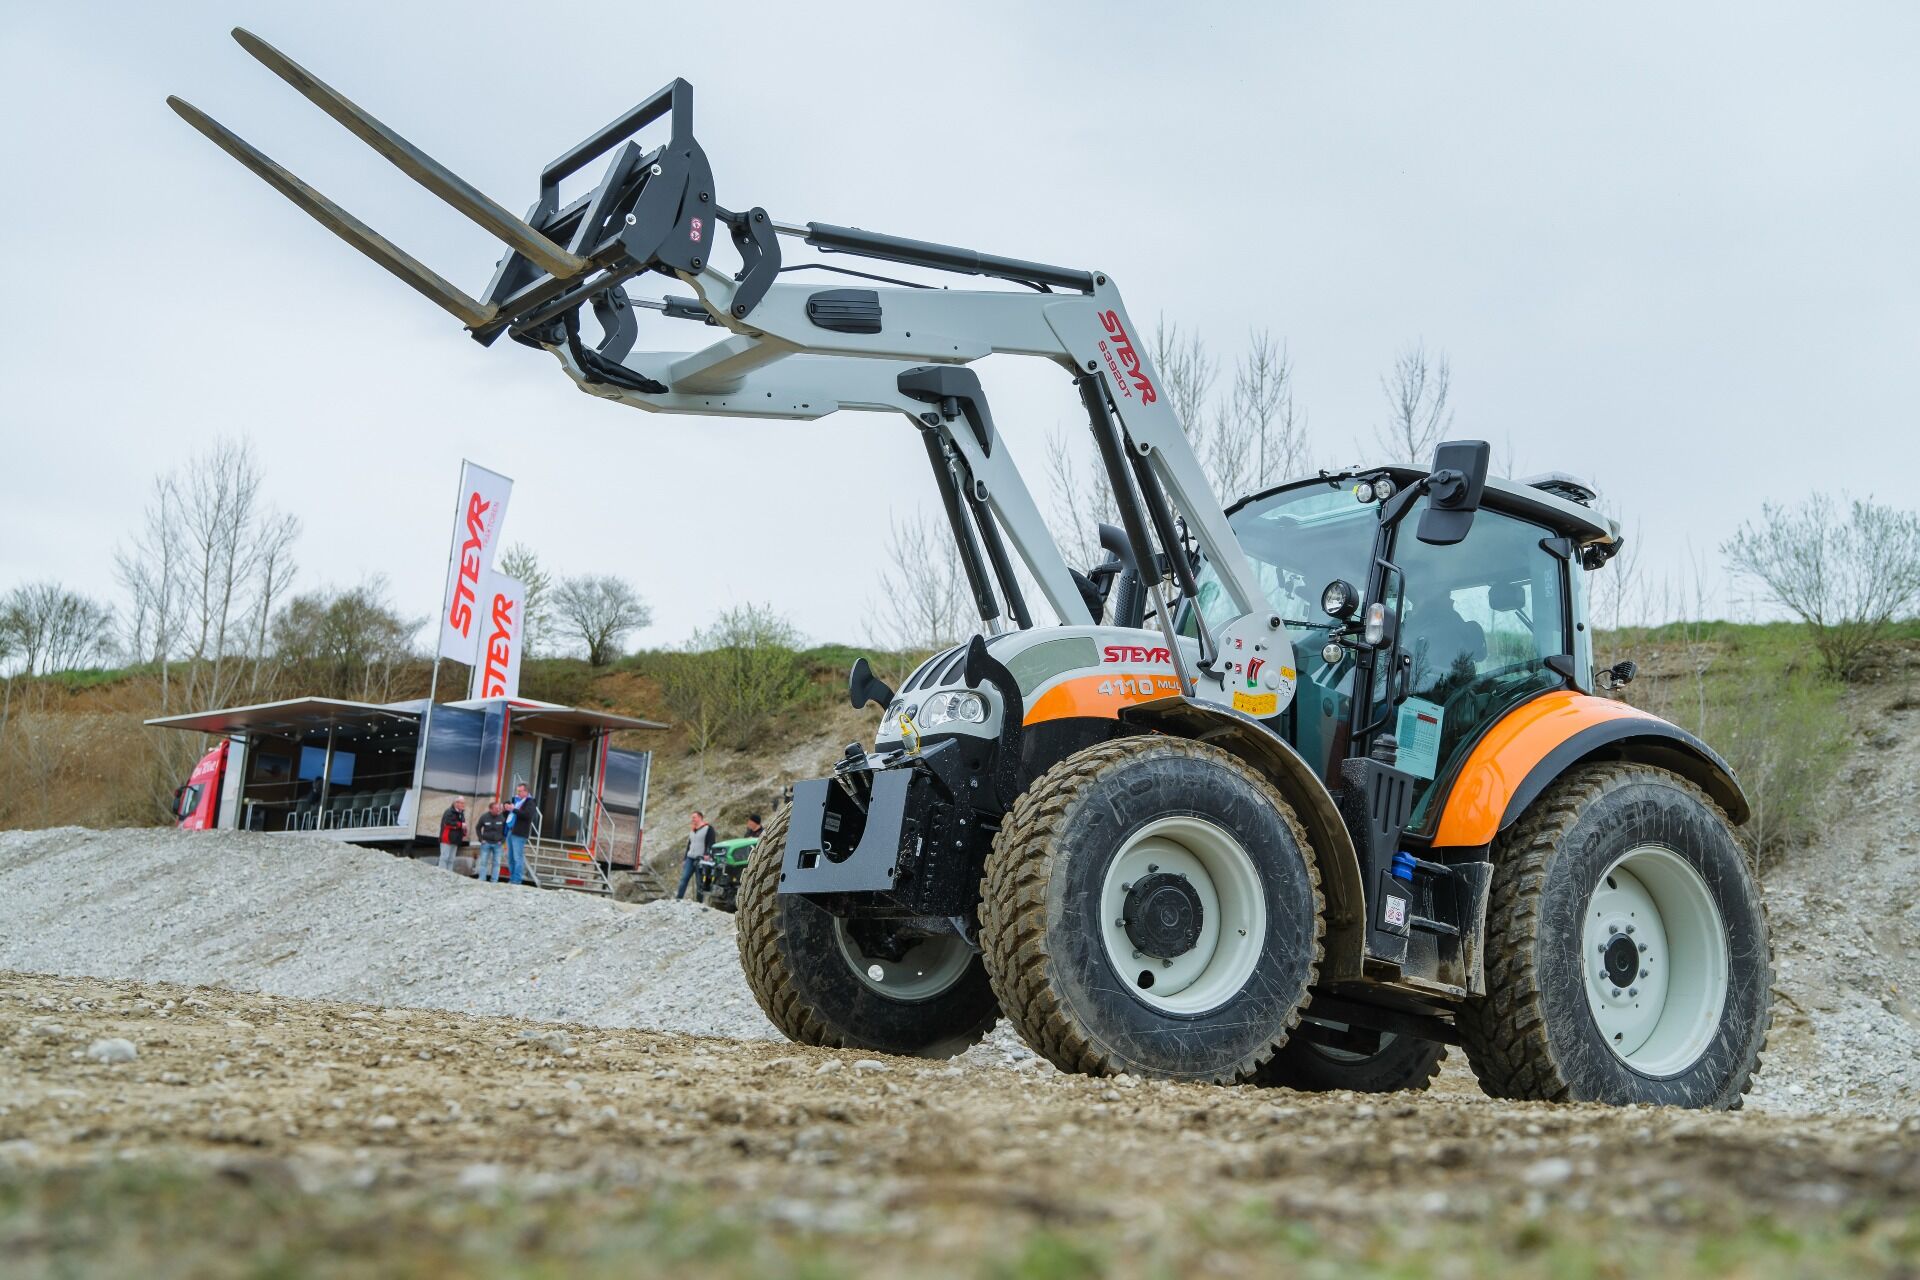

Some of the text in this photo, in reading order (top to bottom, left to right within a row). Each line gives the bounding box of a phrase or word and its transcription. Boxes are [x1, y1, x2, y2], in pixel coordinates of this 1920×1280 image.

[1097, 309, 1157, 406] STEYR
[1098, 340, 1132, 397] S3920T
[450, 491, 490, 639] STEYR
[1103, 645, 1171, 664] STEYR
[1098, 679, 1181, 696] 4110 MUL
